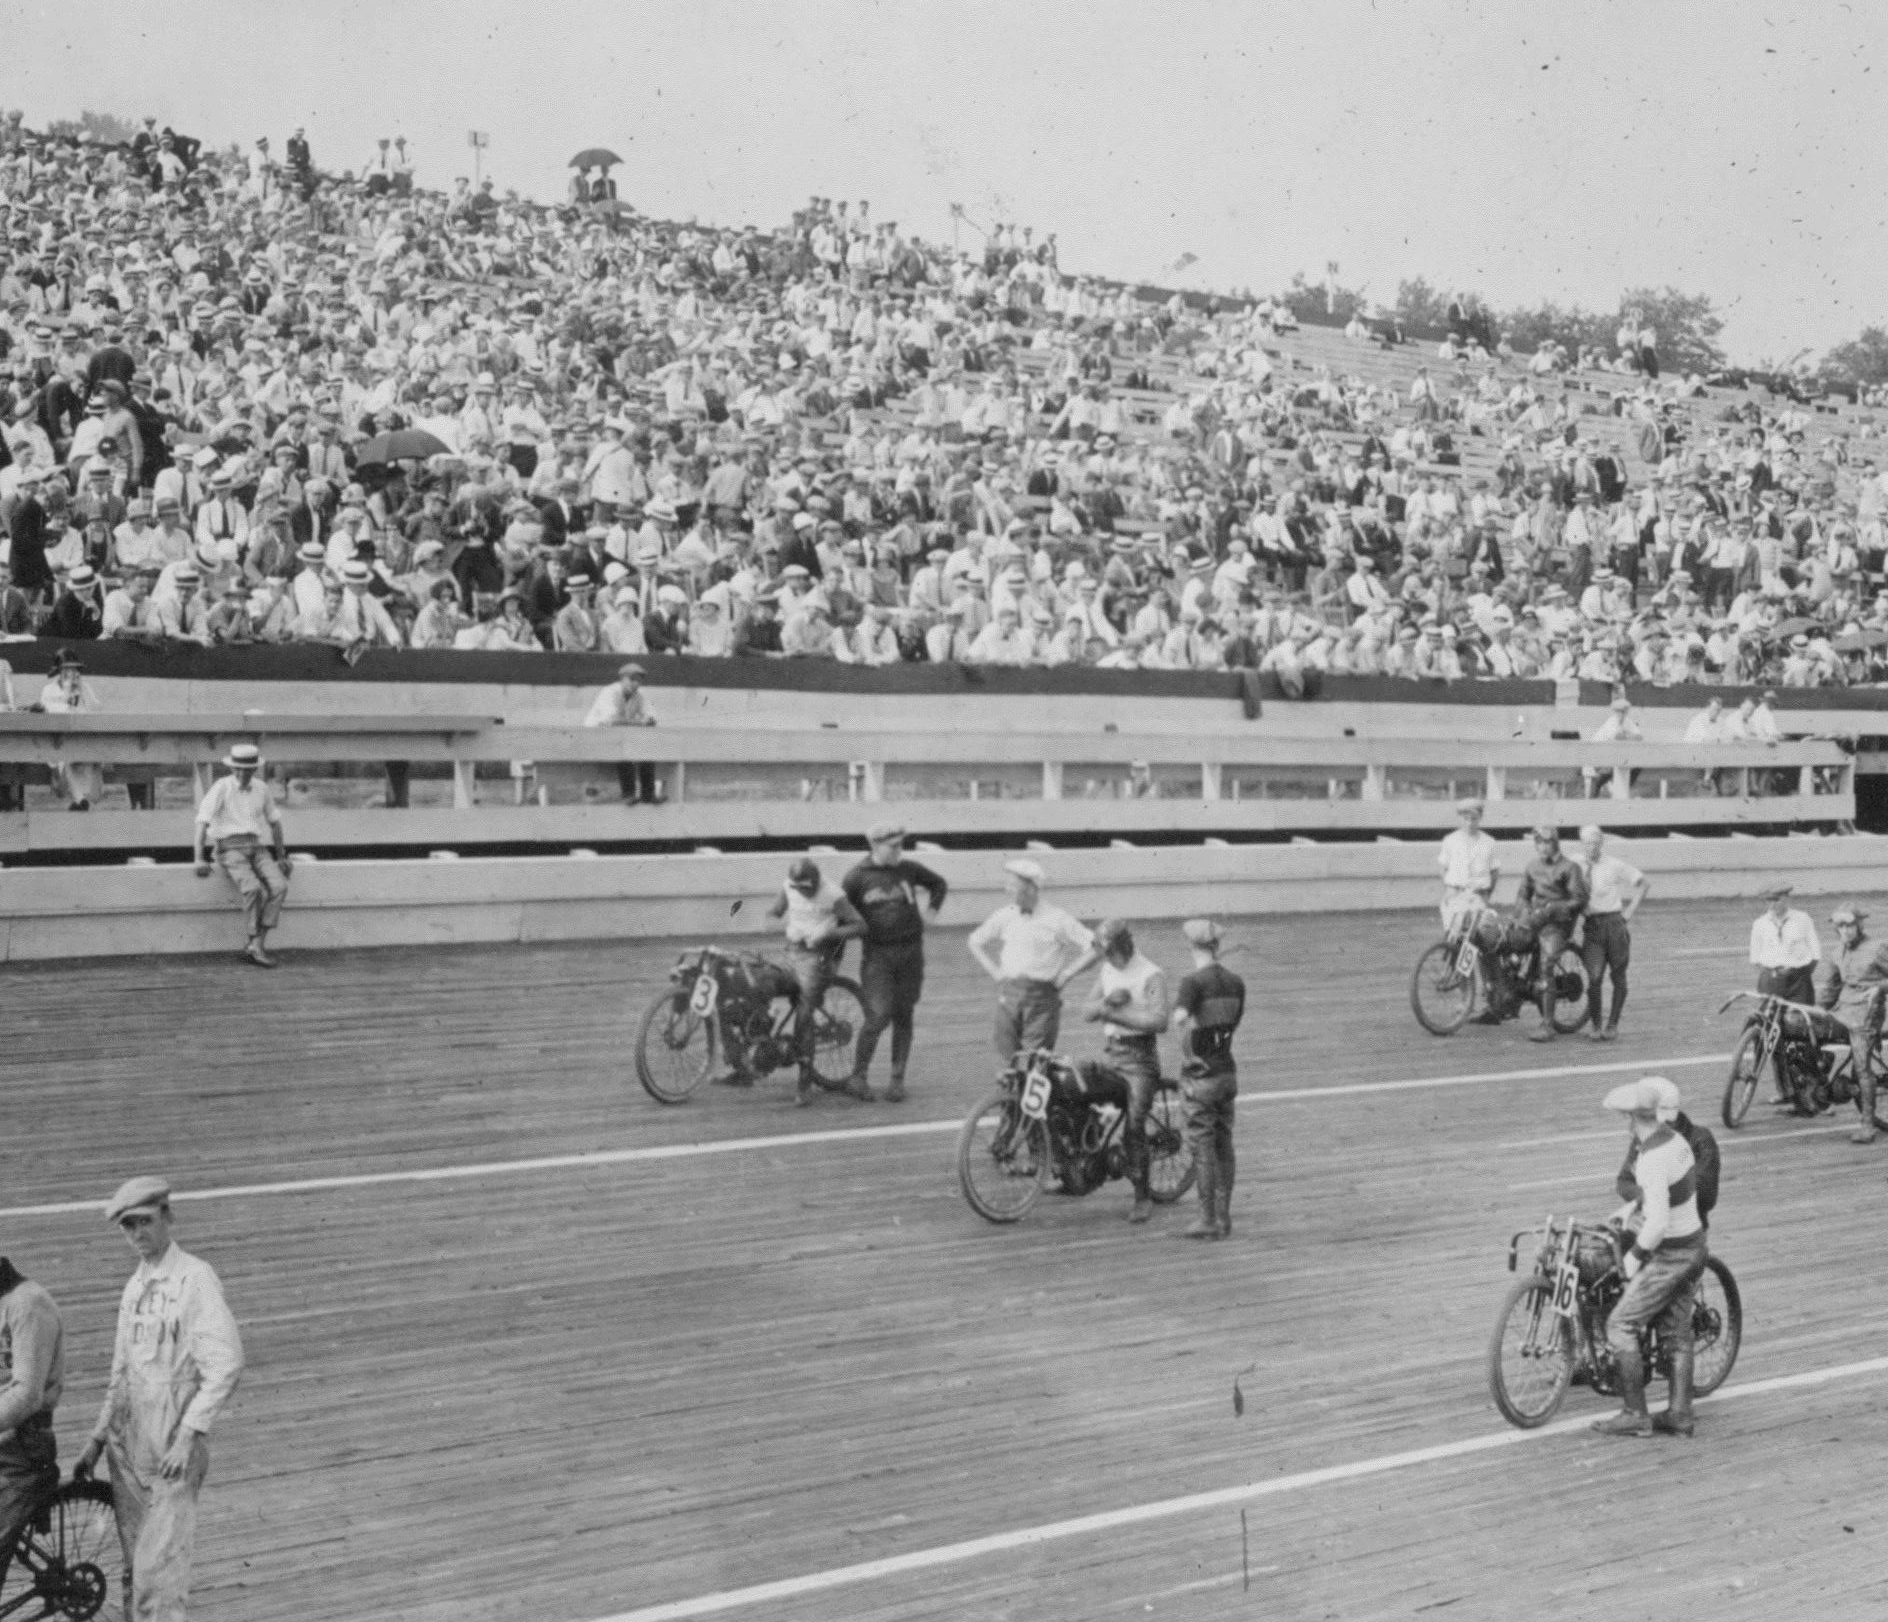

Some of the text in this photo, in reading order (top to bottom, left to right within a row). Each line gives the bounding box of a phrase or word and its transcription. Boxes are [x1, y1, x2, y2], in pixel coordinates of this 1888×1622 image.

[694, 978, 712, 1012] 3
[1024, 1078, 1047, 1112] 5
[1554, 1268, 1575, 1310] 16
